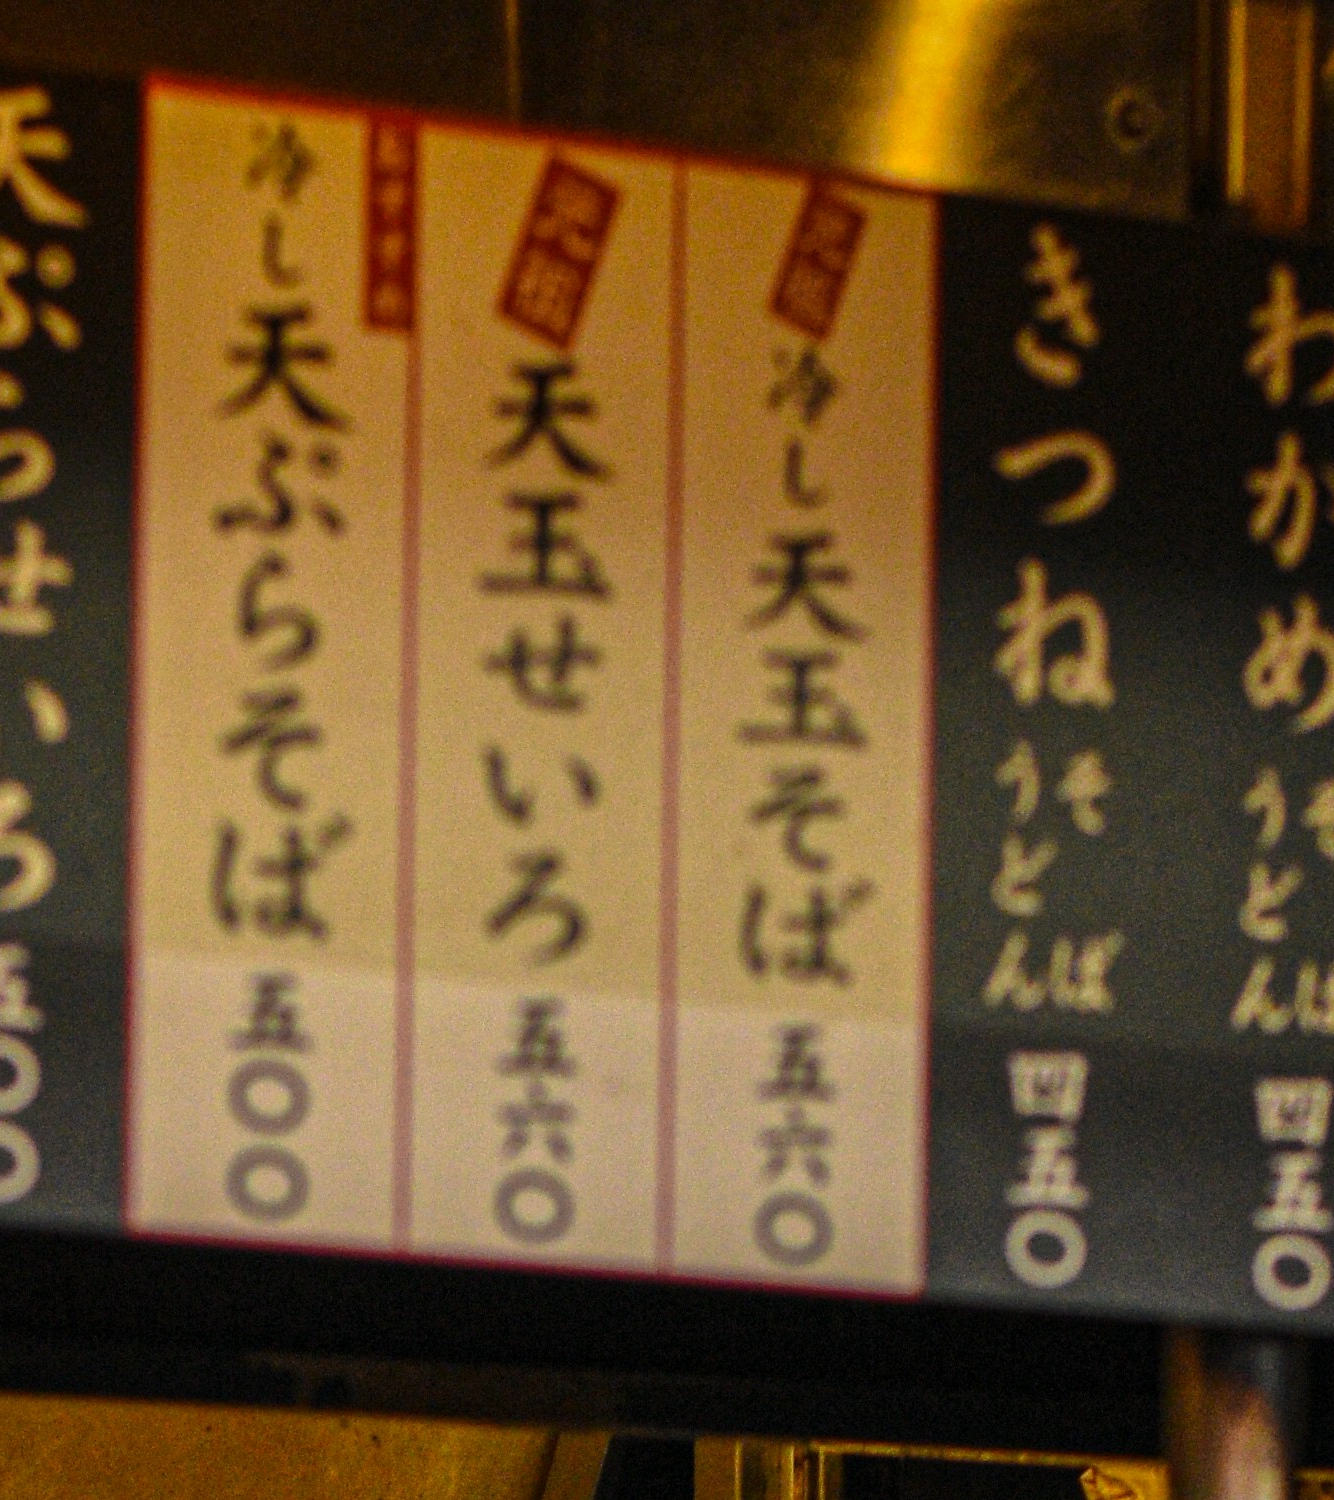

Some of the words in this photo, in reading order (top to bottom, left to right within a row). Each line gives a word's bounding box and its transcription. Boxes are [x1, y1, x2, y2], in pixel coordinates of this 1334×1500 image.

[484, 356, 610, 958] 天玉せいろ
[997, 228, 1113, 706] きつね
